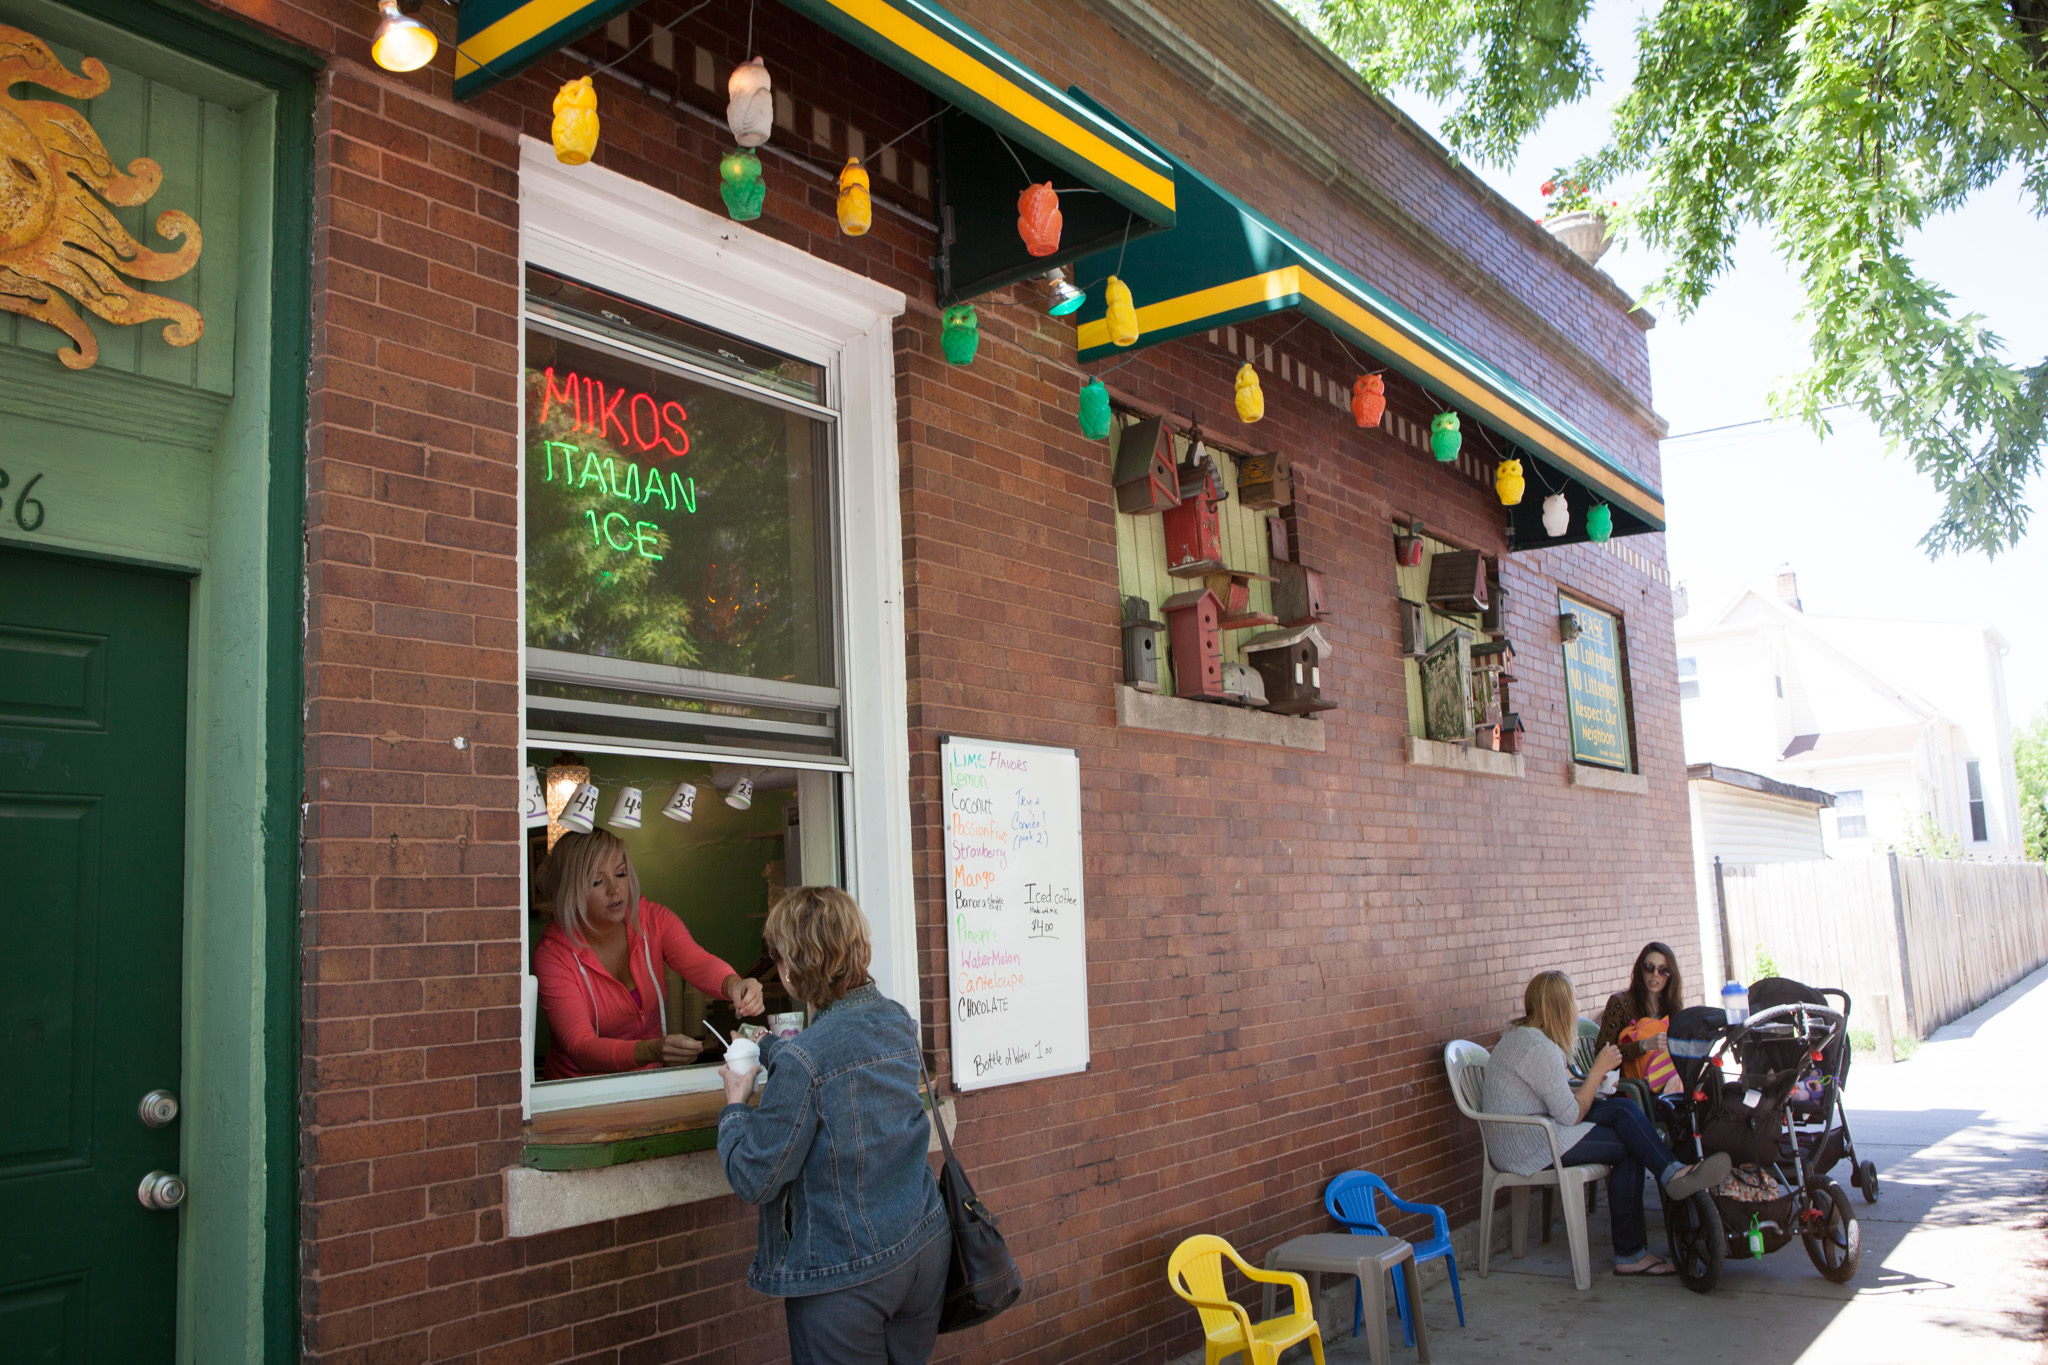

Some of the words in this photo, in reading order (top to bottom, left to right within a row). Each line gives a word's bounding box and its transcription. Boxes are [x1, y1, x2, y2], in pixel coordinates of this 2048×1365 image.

[541, 367, 689, 456] MIKOS
[544, 440, 696, 513] ITALIAN
[585, 510, 663, 560] ICE
[1580, 642, 1615, 679] Loitering
[1570, 667, 1582, 691] NO
[1583, 672, 1616, 707] Littering
[1575, 699, 1603, 722] Respect
[1605, 708, 1616, 725] Our
[1582, 724, 1616, 746] Neighbors
[949, 762, 988, 789] Lemon
[951, 788, 993, 815] Coconut
[952, 839, 1008, 870] Strawberry
[954, 864, 995, 890] Mango
[955, 888, 986, 909] Banana
[1024, 883, 1052, 905] Iced
[957, 970, 1026, 994] Canteloupe
[958, 996, 1009, 1022] CHOCOLATE
[973, 1049, 1003, 1077] Bottle
